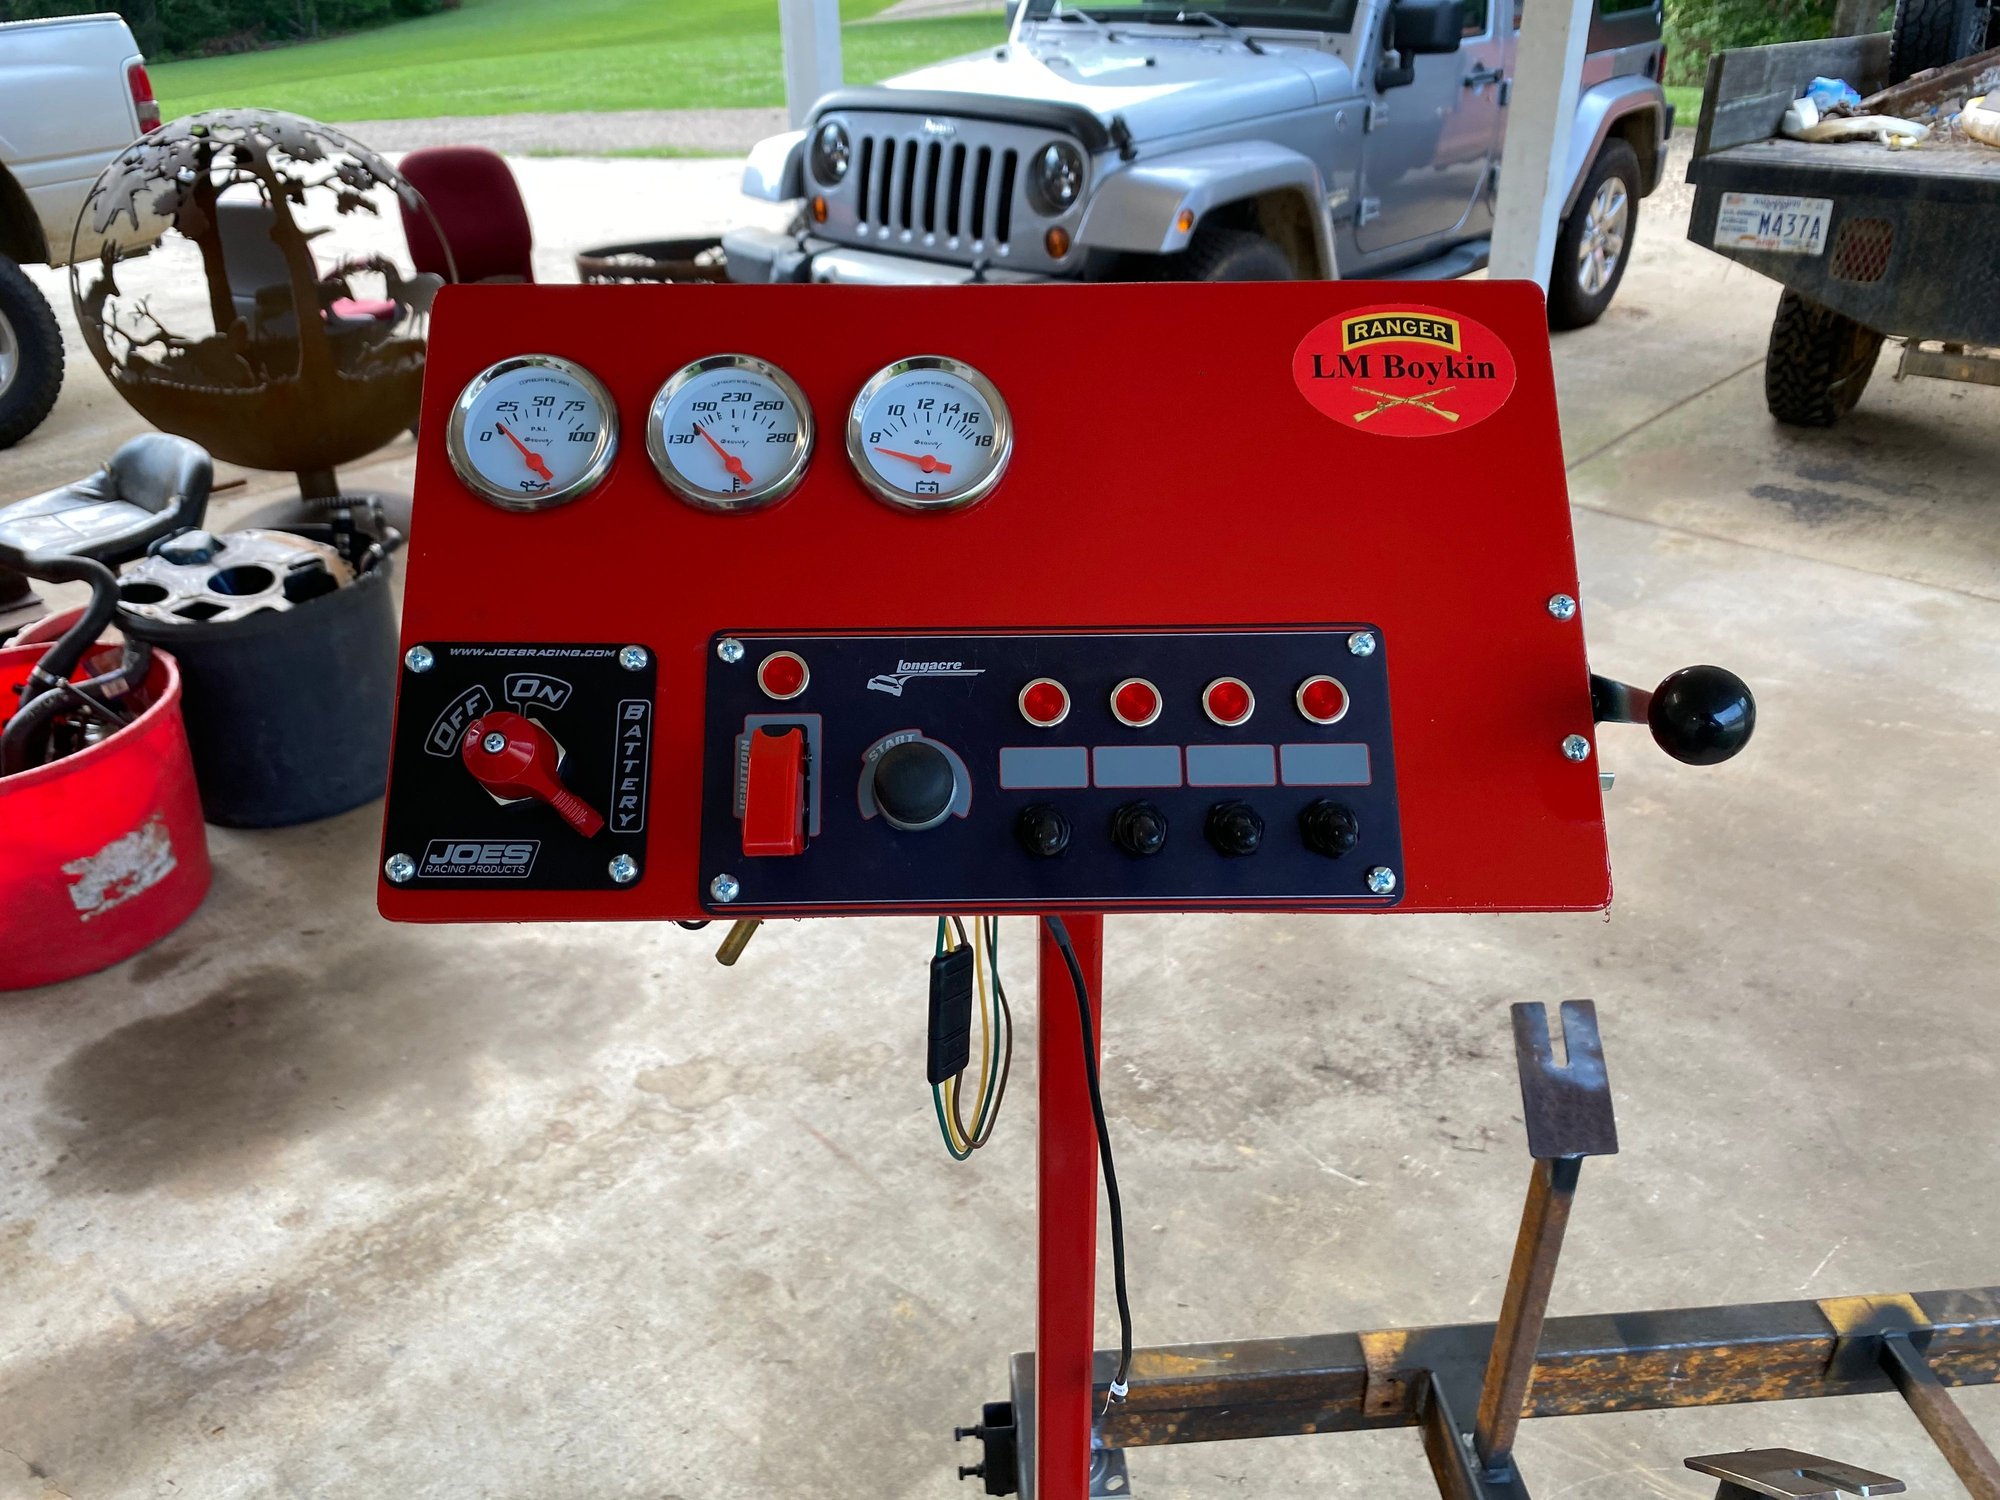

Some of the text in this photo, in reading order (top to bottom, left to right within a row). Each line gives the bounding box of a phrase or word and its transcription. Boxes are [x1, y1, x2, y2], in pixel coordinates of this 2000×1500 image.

[1758, 211, 1821, 240] M437A
[1354, 319, 1448, 340] RANGER
[1311, 354, 1496, 385] LM Boykin
[531, 396, 556, 406] 50
[721, 392, 752, 402] 230
[496, 401, 520, 411] 25
[564, 401, 586, 411] 75
[692, 402, 718, 411] 190
[753, 401, 784, 411] 260
[887, 404, 906, 416] 10
[917, 398, 935, 410] 12
[943, 402, 960, 414] 14
[962, 412, 980, 424] 16
[479, 432, 493, 441] 0
[568, 432, 596, 442] 100
[669, 434, 695, 444] 130
[766, 433, 797, 443] 280
[869, 431, 882, 443] 8
[974, 435, 993, 447] 18
[450, 648, 616, 657] WWW.JOESRACING.COM
[897, 660, 962, 673] Longacre
[512, 679, 564, 703] ON
[434, 693, 481, 750] OFF
[868, 733, 915, 761] START
[618, 705, 646, 827] BATTERY
[429, 844, 533, 864] JOES
[424, 864, 526, 874] RACING PRODUCTS
